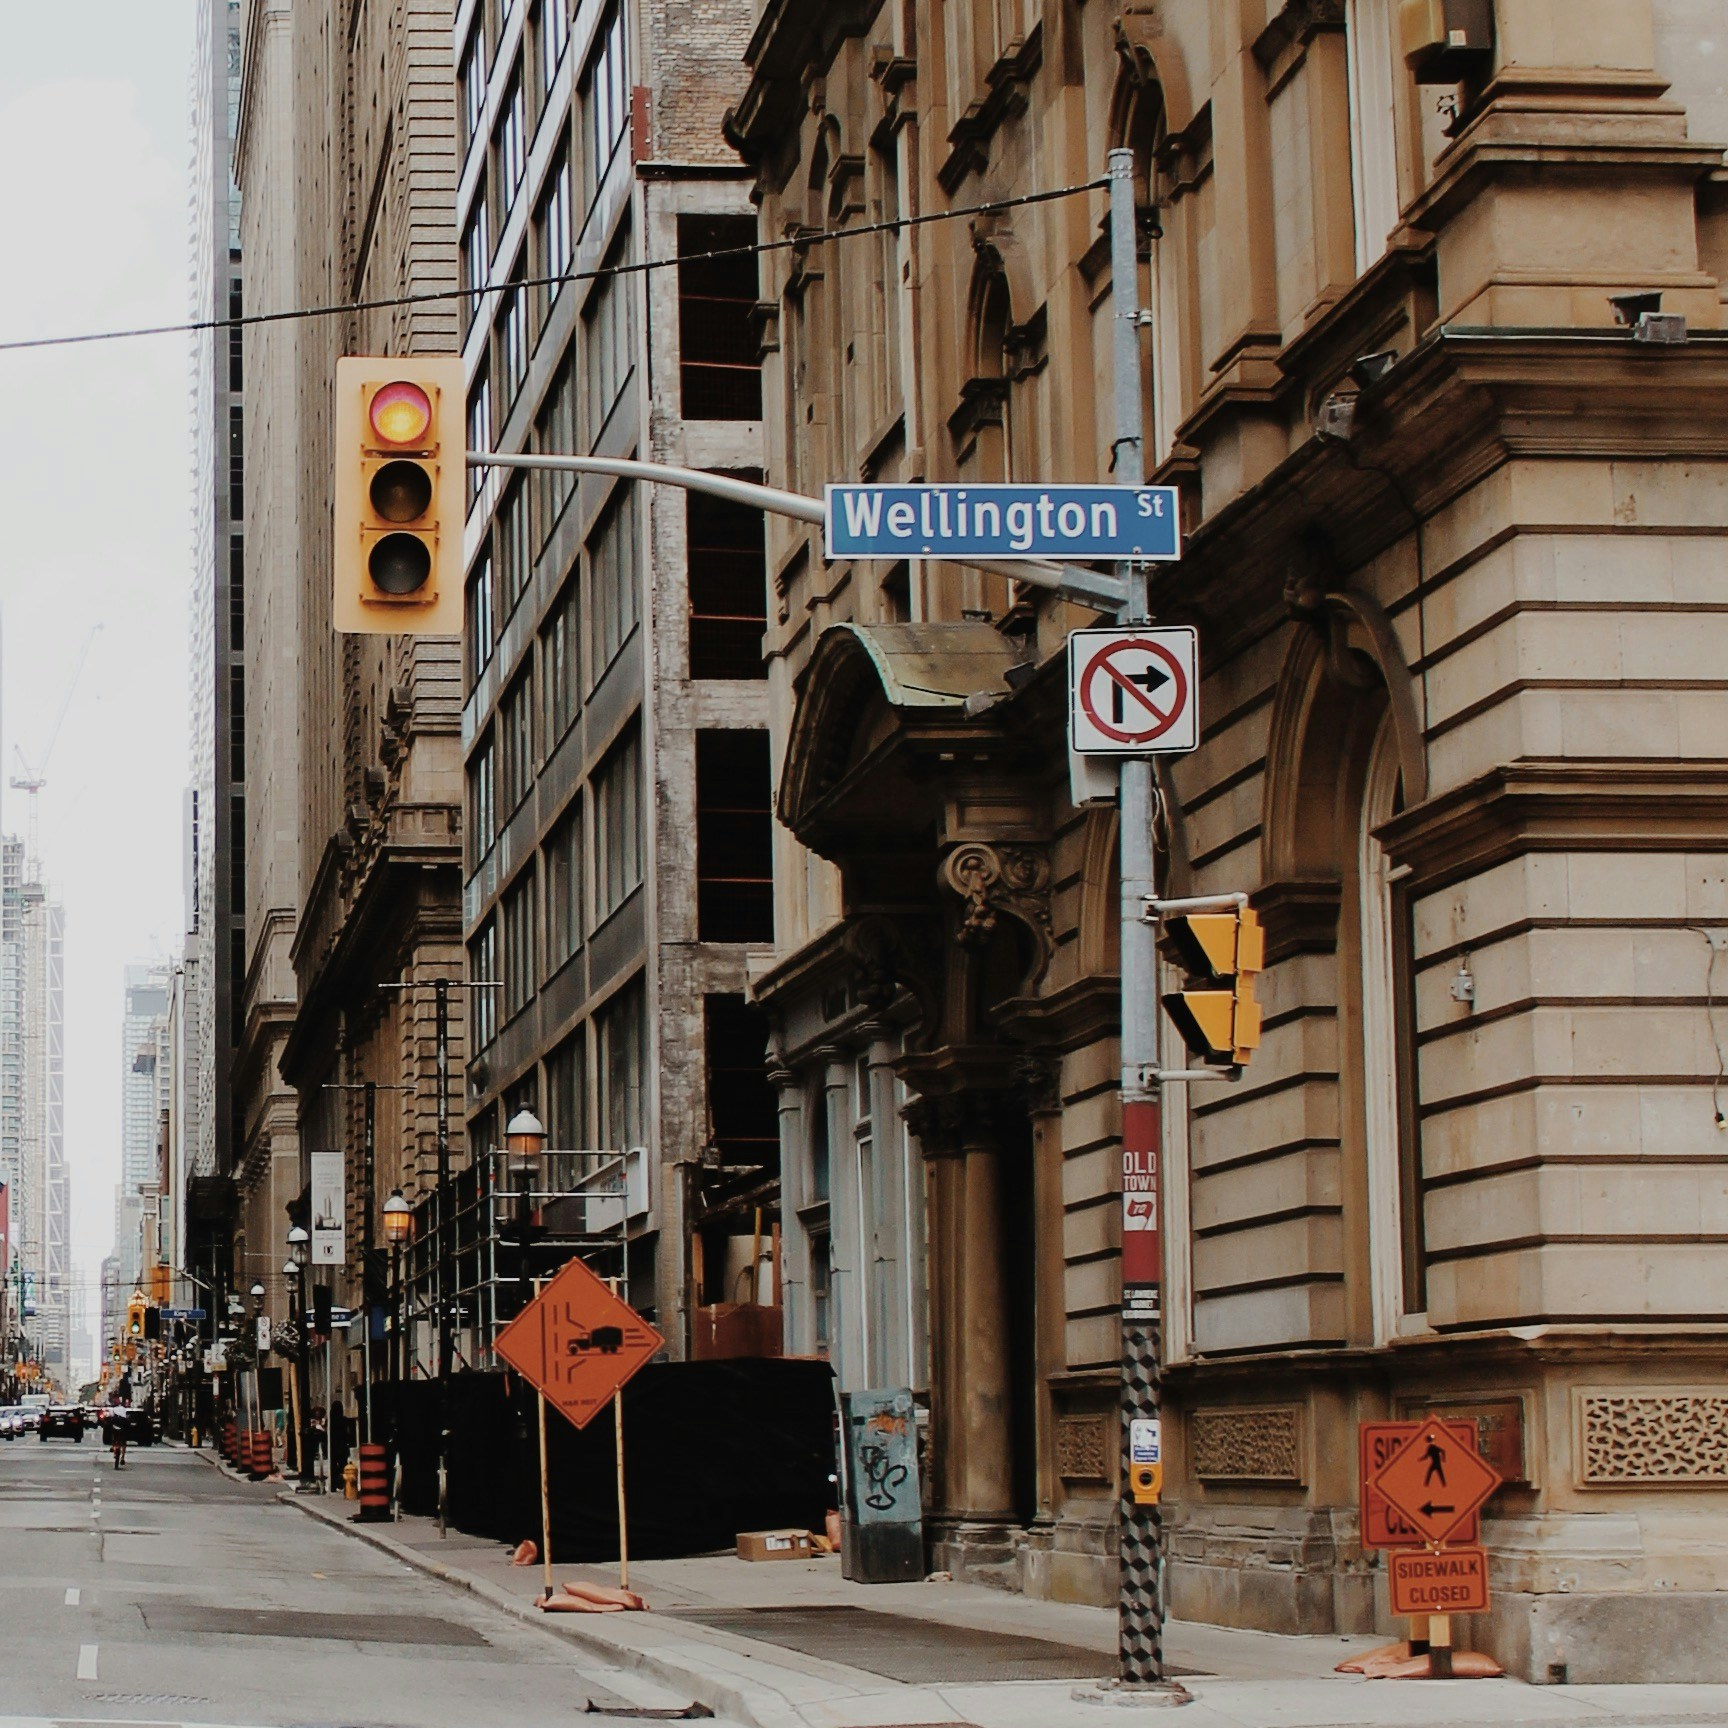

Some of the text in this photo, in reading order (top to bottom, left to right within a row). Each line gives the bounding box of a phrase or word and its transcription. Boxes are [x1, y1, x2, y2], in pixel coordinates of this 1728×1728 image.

[843, 491, 1164, 550] Wellington St
[1123, 1151, 1157, 1174] OLD
[1124, 1175, 1157, 1191] TOWN
[1398, 1560, 1479, 1579] SIDEWALK
[1409, 1585, 1471, 1604] CLOSED
